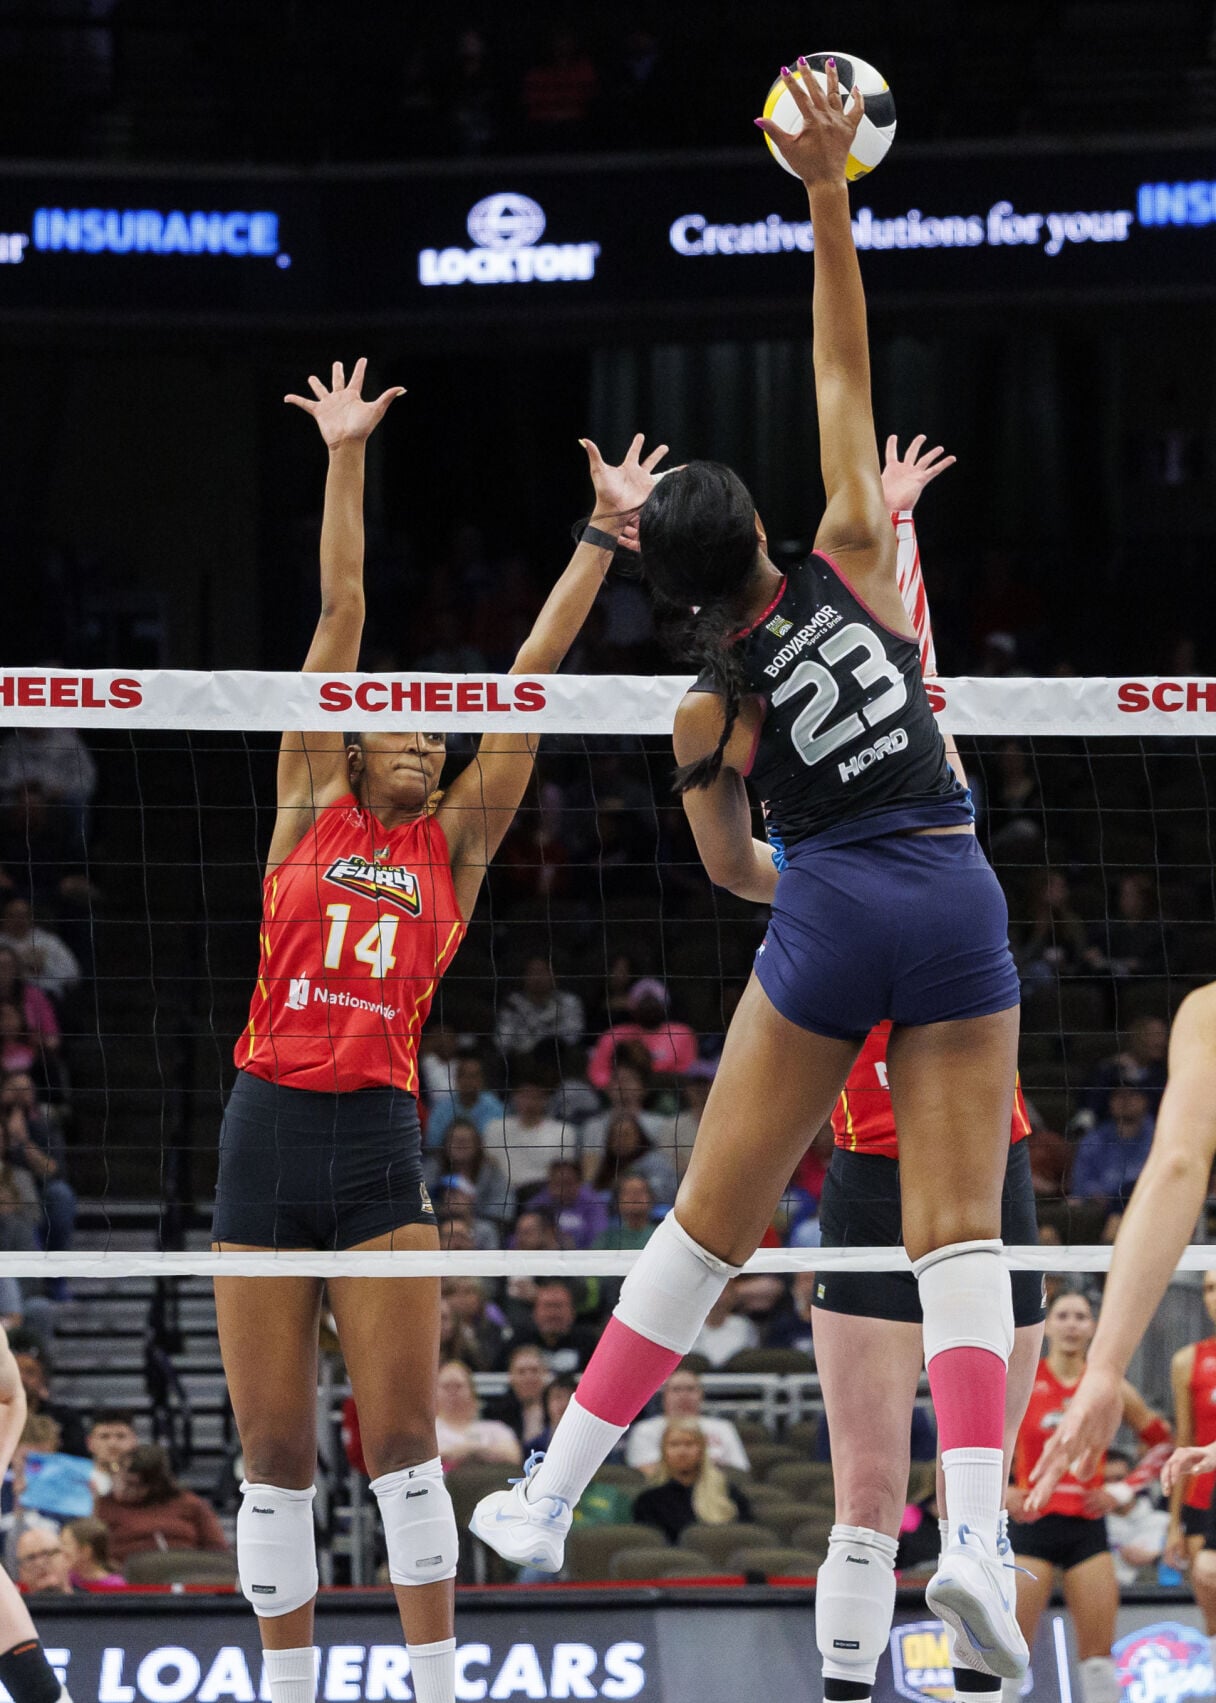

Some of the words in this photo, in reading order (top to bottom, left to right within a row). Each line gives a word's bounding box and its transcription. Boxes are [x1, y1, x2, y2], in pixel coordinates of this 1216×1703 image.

[669, 213, 815, 255] Creative
[851, 207, 984, 250] lutions
[987, 201, 1044, 246] for
[1044, 209, 1134, 257] your
[1137, 181, 1216, 228] INS
[418, 245, 596, 286] LOCKTON
[763, 604, 838, 678] BODYARMOR
[807, 627, 828, 646] Sports
[826, 614, 844, 630] Drink
[318, 681, 547, 713] SCHEELS
[771, 622, 907, 766] 23
[838, 728, 909, 783] HORD
[330, 861, 414, 896] FURY
[324, 903, 400, 979] 14
[313, 987, 396, 1020] Nationwide
[98, 1645, 413, 1702] LOAER
[455, 1643, 645, 1700] CARS
